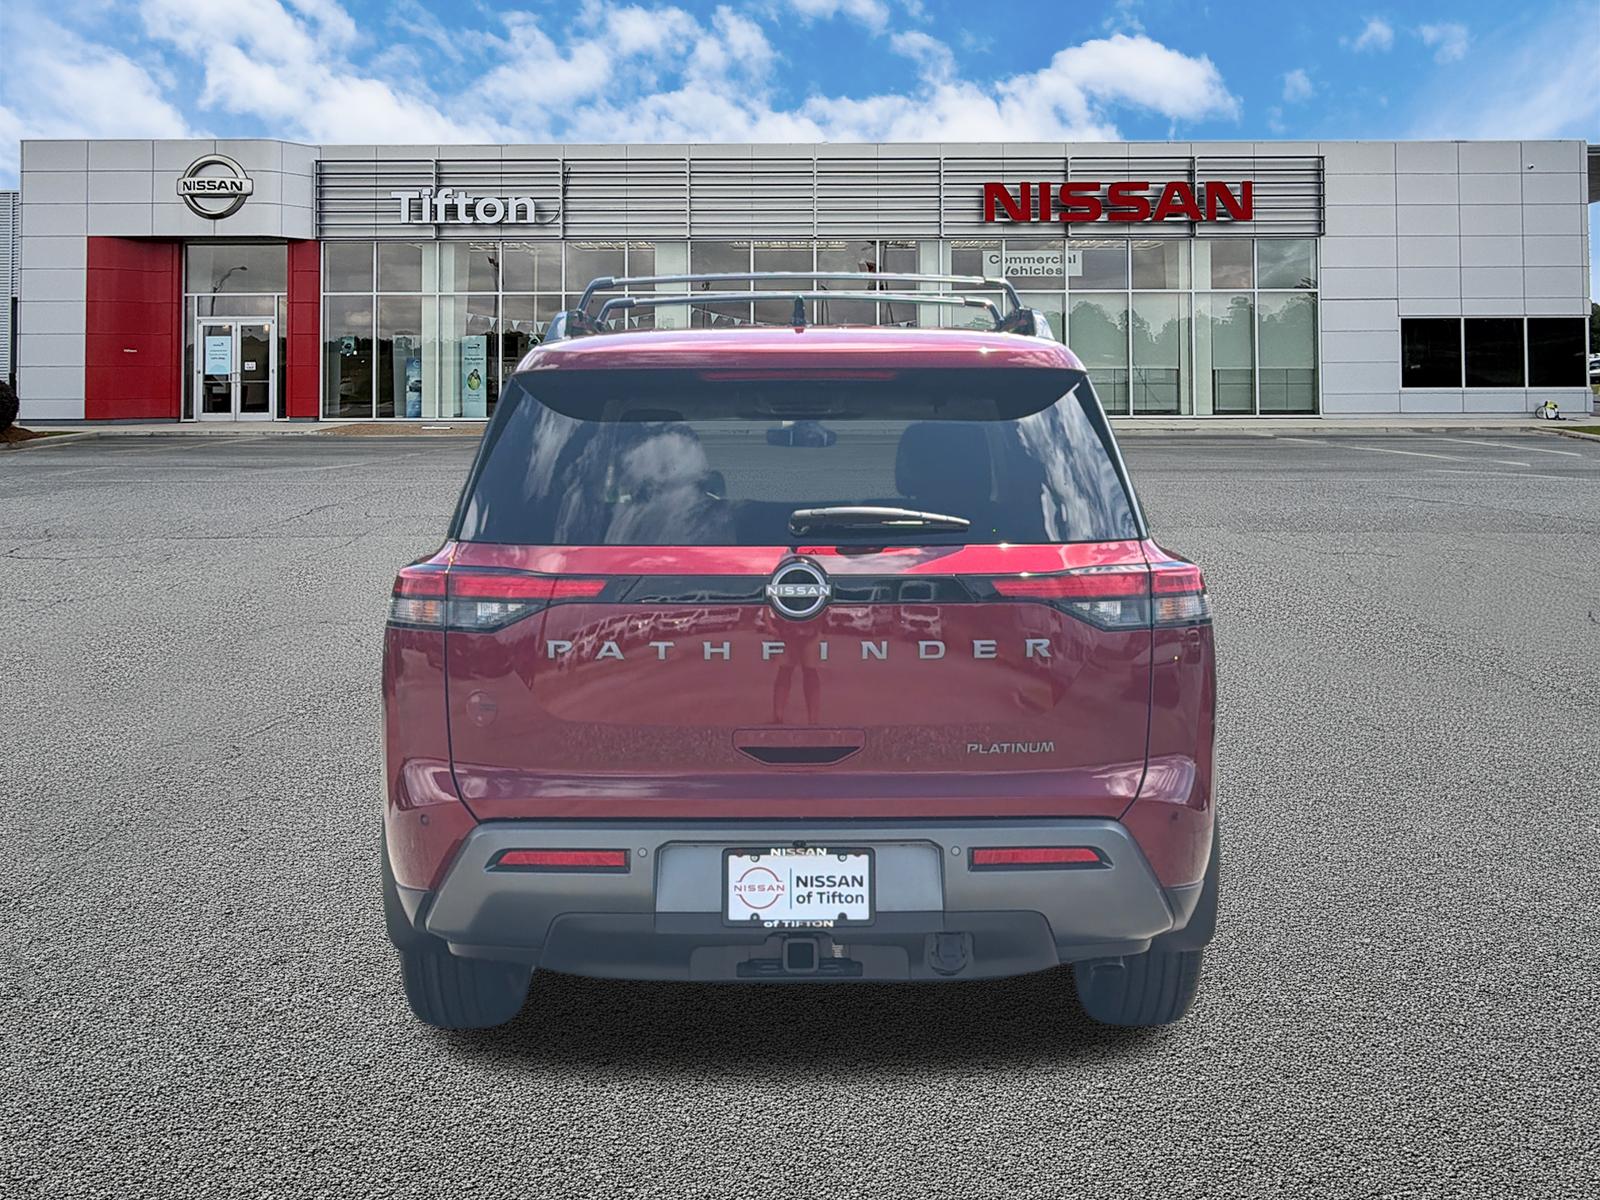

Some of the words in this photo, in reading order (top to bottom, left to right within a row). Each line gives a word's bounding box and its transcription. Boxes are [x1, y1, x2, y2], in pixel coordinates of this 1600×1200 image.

[182, 180, 243, 191] NISSAN
[390, 187, 536, 224] Tifton
[984, 181, 1253, 222] NISSAN
[767, 586, 830, 595] NISSAN
[546, 638, 1052, 660] PATHFINDER
[966, 742, 1055, 754] PLATINUM
[770, 848, 827, 856] NISSAN
[796, 875, 864, 888] NISSAN
[733, 884, 785, 892] NISSAN
[796, 891, 812, 904] of
[816, 891, 864, 904] Tifton
[763, 920, 779, 928] of
